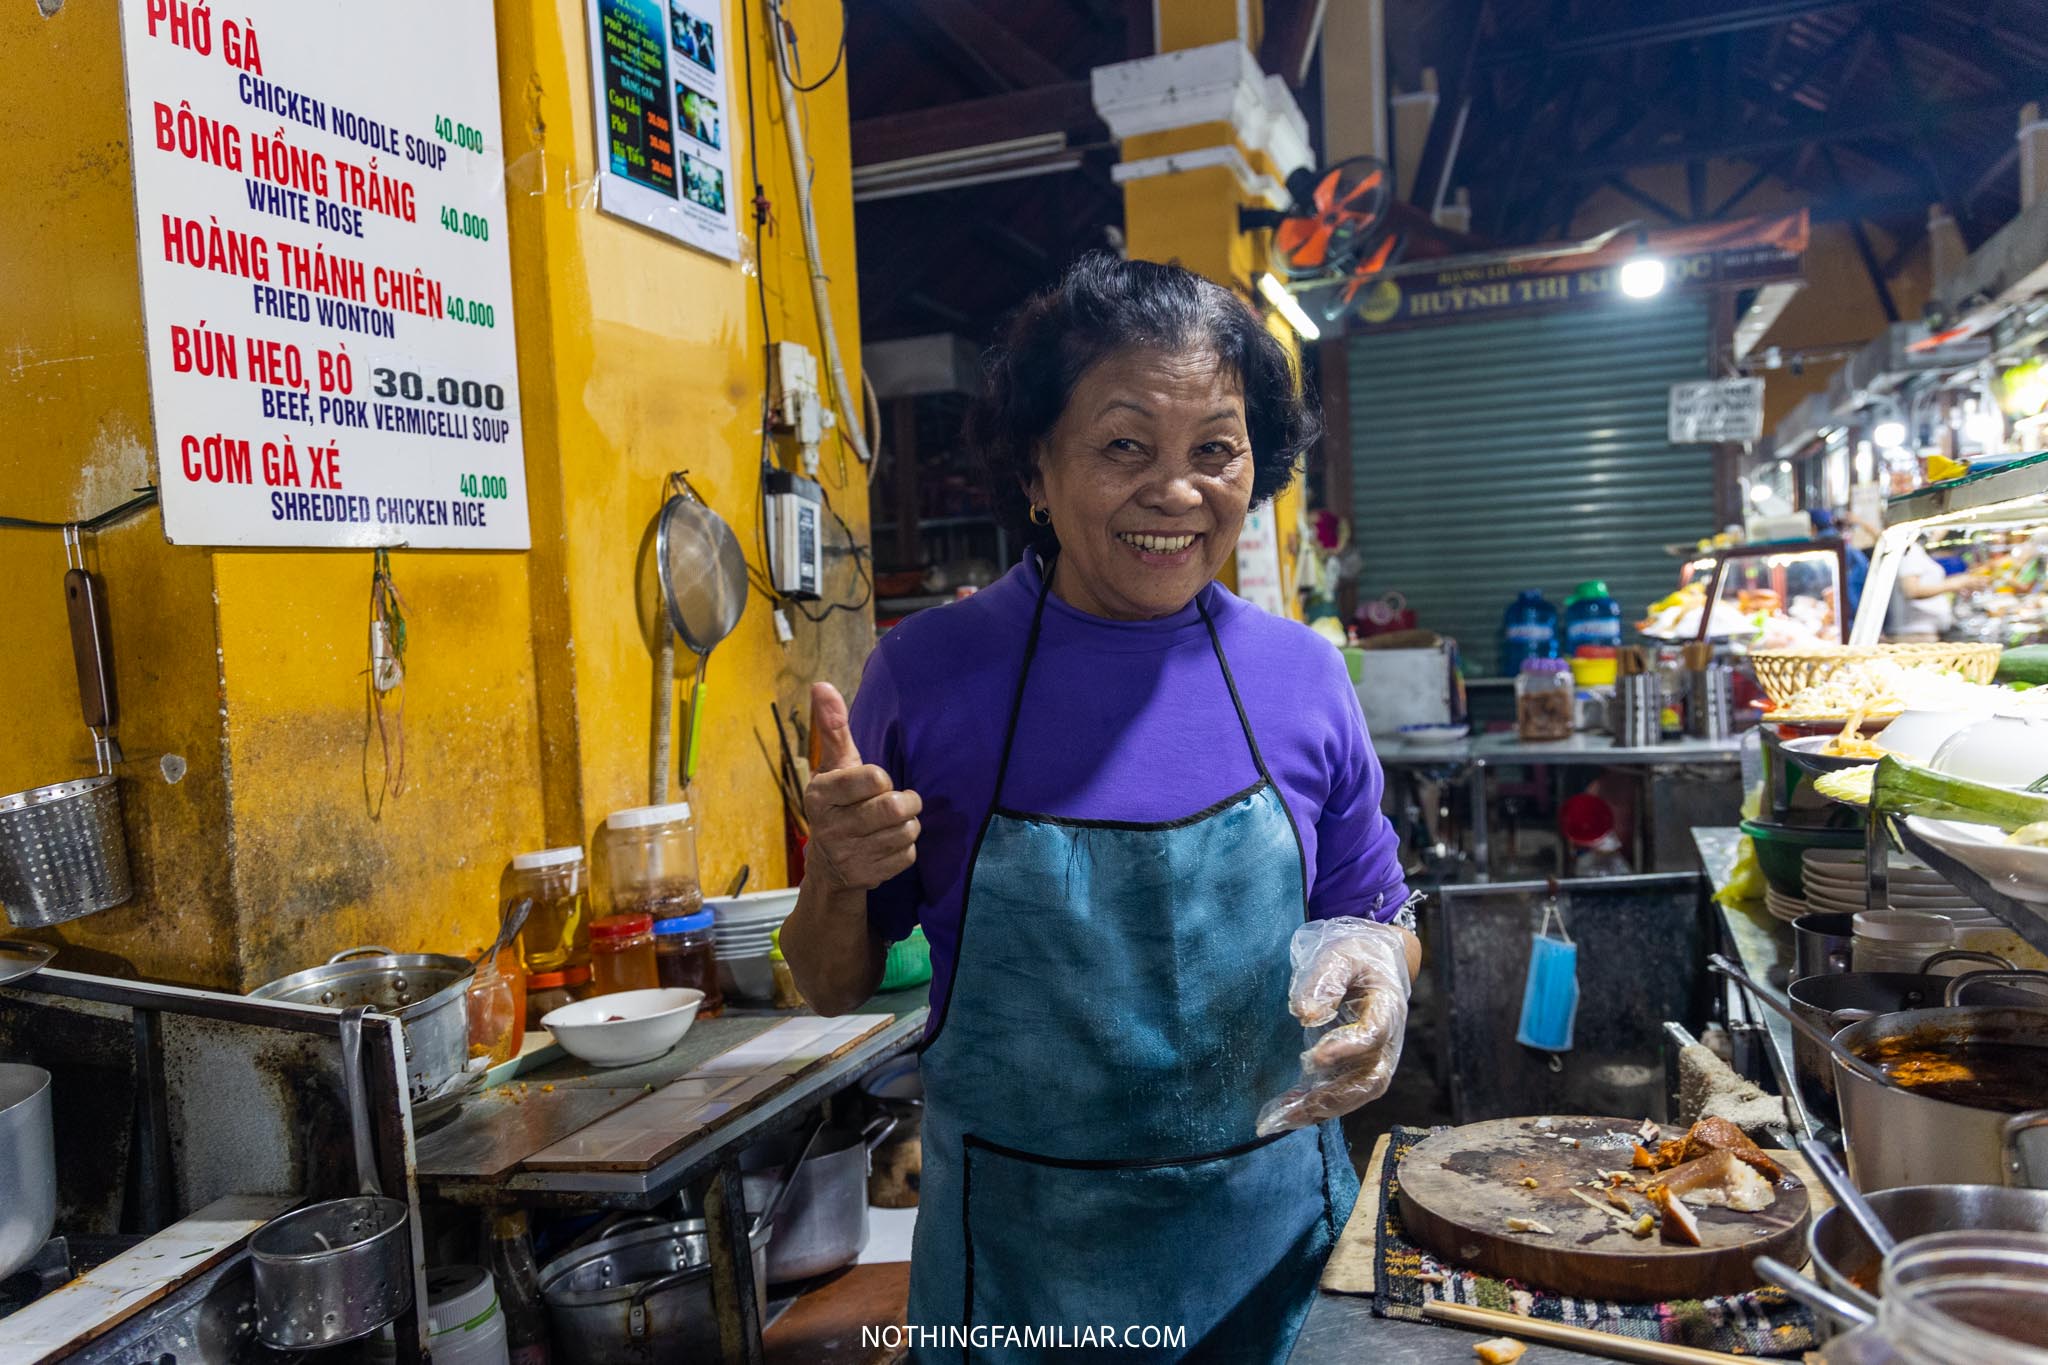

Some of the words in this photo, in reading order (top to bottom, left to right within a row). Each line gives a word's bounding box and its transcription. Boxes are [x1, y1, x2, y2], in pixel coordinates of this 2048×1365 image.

[222, 18, 262, 76] GÀ
[239, 73, 326, 130] CHICKEN
[332, 108, 400, 156] NOODLE
[405, 133, 447, 171] SOUP
[435, 115, 483, 155] 40.000
[154, 100, 242, 173] BÔNG
[251, 128, 328, 197] HỒNG
[335, 157, 416, 222] TRẮNG
[245, 179, 309, 224] WHITE
[316, 199, 363, 238] ROSE
[441, 207, 488, 241] 40.000
[162, 214, 270, 282] HOÀNG
[277, 242, 366, 302] THÁNH
[374, 267, 443, 319] CHIÊN
[254, 284, 310, 322] FRIED
[316, 297, 394, 339] WONTON
[447, 296, 494, 329] 40.000
[171, 320, 238, 380] BÚN
[246, 338, 310, 393] HEO,
[318, 343, 352, 395] BÒ
[262, 388, 313, 426] BEEF,
[319, 396, 368, 428] PORK
[372, 403, 469, 439] VERMICELLI
[473, 416, 509, 443] SOUP
[373, 368, 504, 411] 30.000
[181, 433, 253, 484] CƠM
[262, 435, 301, 487] GÀ
[308, 439, 342, 490] XÉ
[460, 473, 507, 500] 40.000
[271, 491, 369, 522] SHREDDED
[376, 497, 447, 525] CHICKEN
[453, 502, 485, 526] RICE
